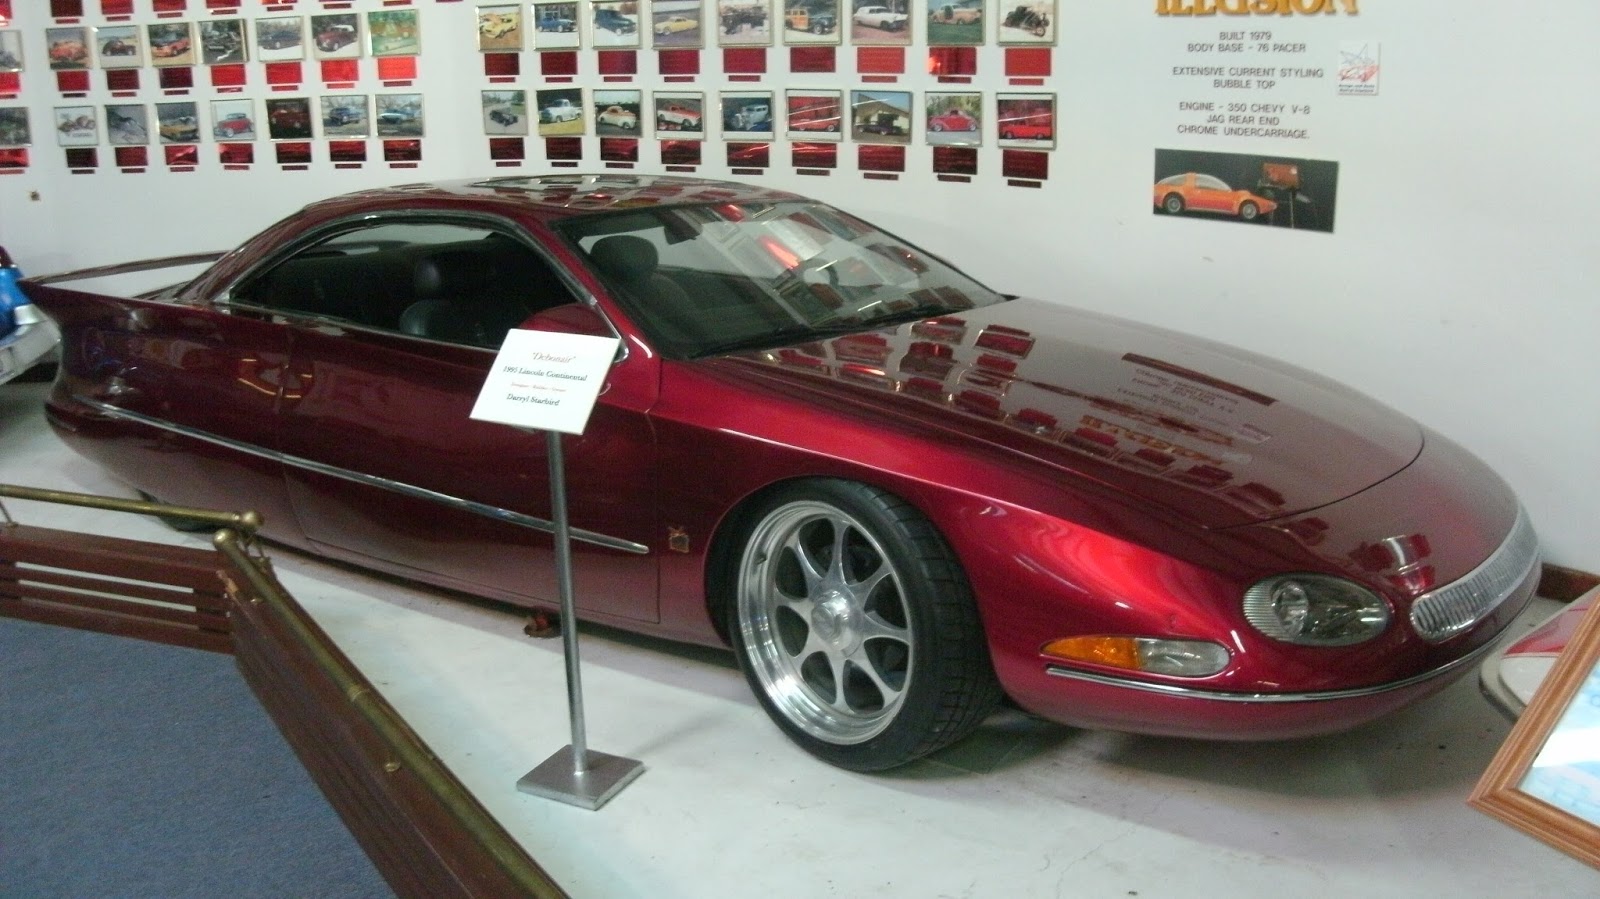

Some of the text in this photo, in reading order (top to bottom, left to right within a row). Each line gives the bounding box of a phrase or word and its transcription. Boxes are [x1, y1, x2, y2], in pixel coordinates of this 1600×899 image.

[1219, 31, 1272, 41] BUILT 1979
[1187, 43, 1214, 52] BODY
[1218, 43, 1244, 52] BASE
[1257, 43, 1270, 52] 76
[1273, 43, 1306, 53] PACER
[1172, 66, 1324, 79] EXTENSIVE CURRENT STYLING
[1213, 79, 1276, 90] BUBBLE TOP
[1179, 102, 1214, 111] ENGINE
[1227, 103, 1247, 113] 350
[1250, 103, 1285, 114] CHEVY
[1291, 105, 1311, 115] V-8
[1207, 115, 1280, 126] JAG REAR END
[1177, 124, 1310, 139] CHROME UNDERCARRIAGE.
[519, 367, 545, 377] Lincoln
[546, 370, 588, 382] Continental
[506, 393, 561, 406] Darryl Starbird
